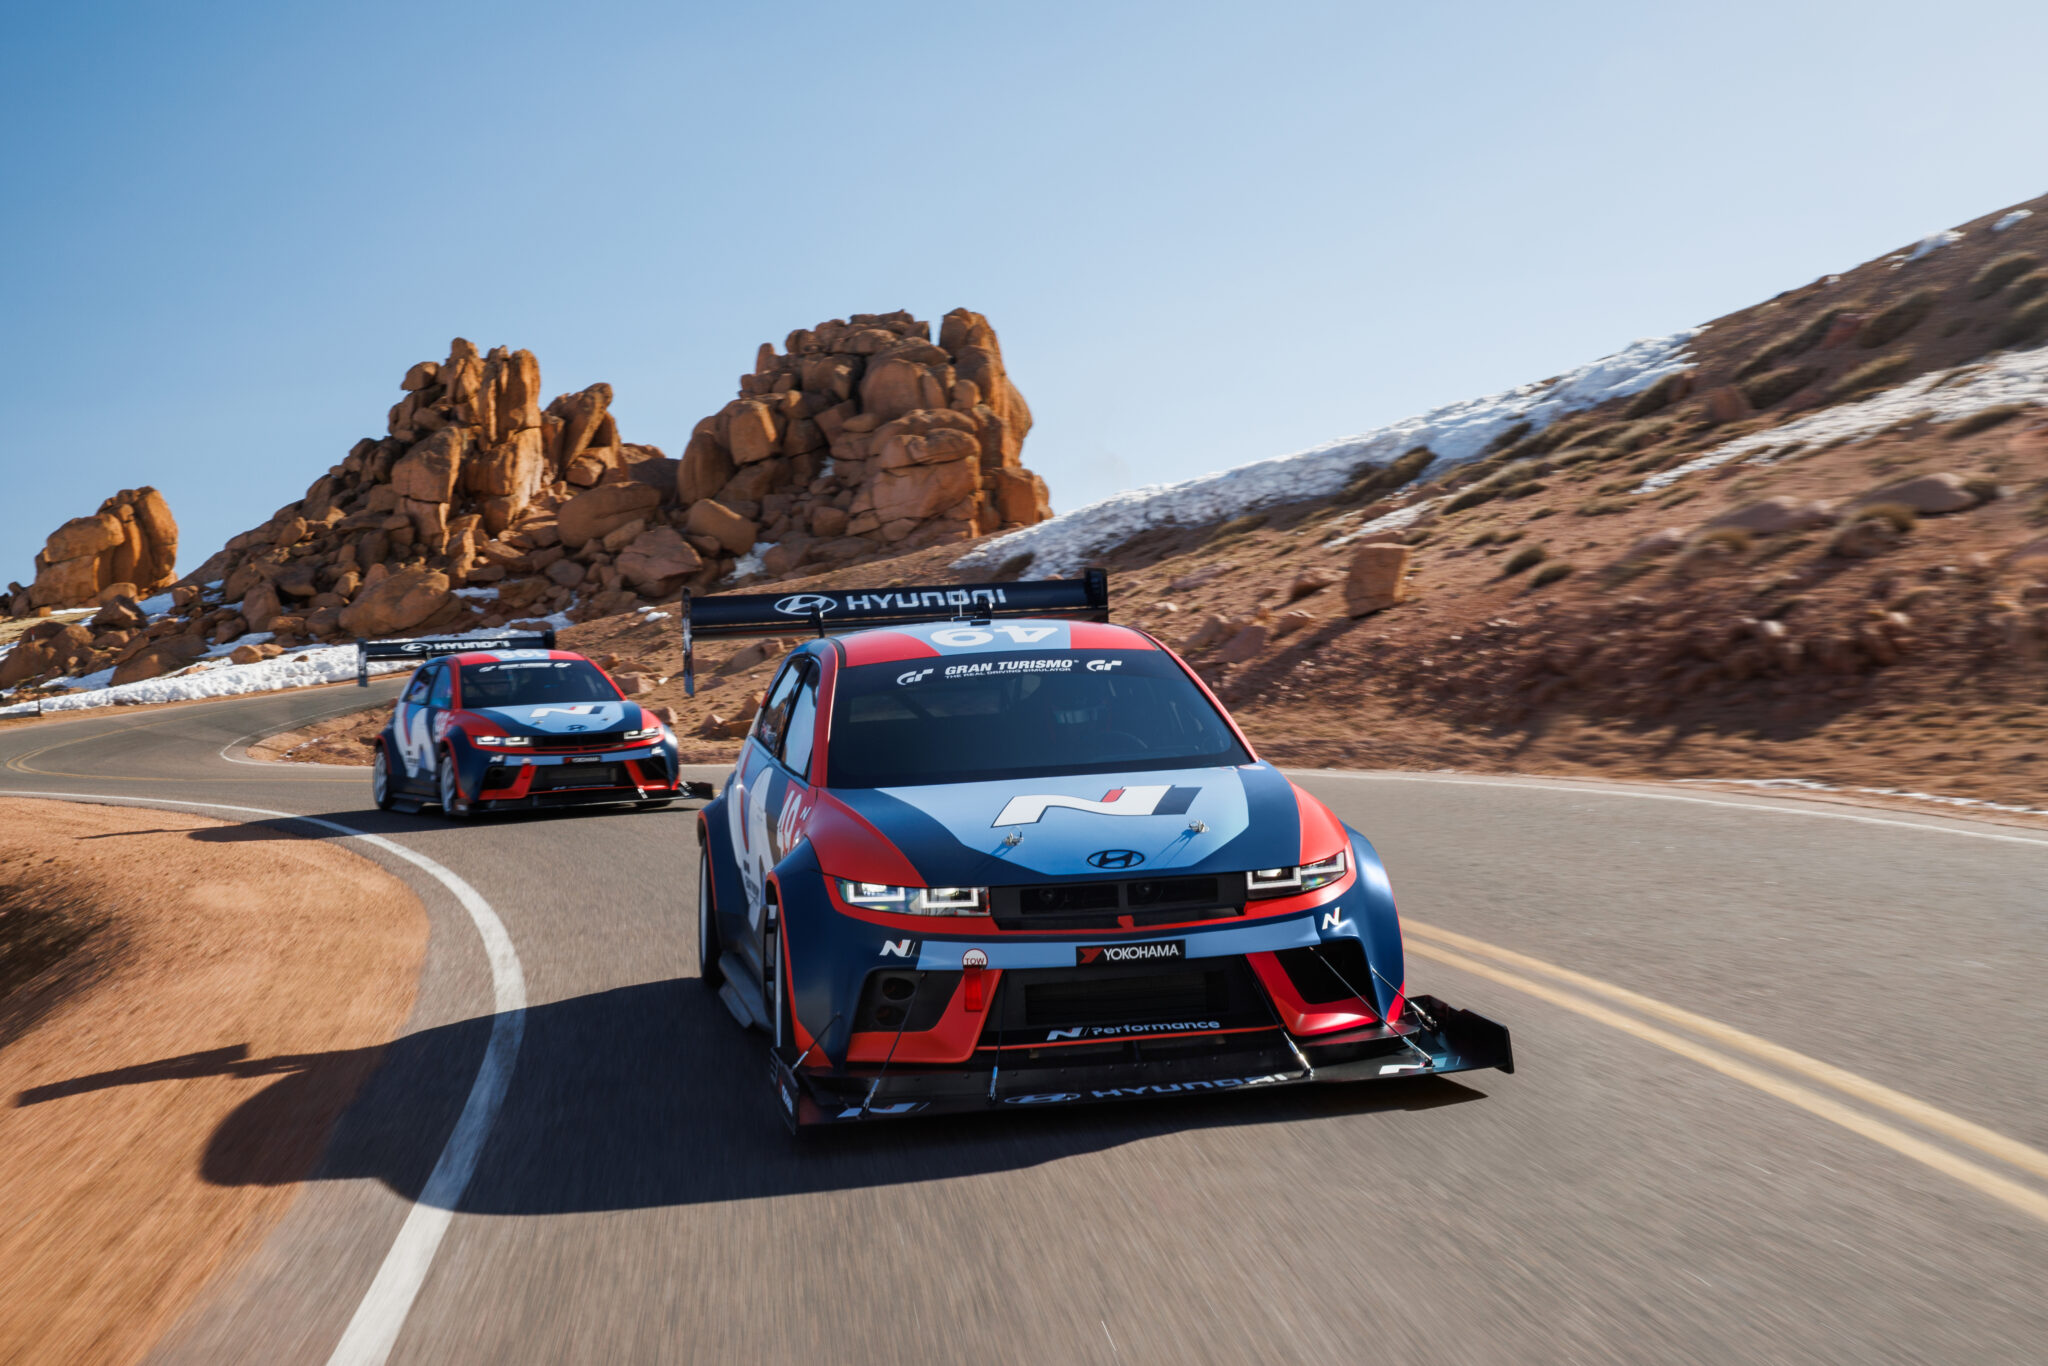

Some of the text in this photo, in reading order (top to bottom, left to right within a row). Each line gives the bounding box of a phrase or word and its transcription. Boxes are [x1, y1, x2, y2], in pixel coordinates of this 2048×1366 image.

[845, 589, 1007, 611] HYUNDAI
[944, 659, 1073, 676] GRAN TURISMO
[1103, 943, 1179, 961] YOKOHAMA
[965, 957, 985, 966] TOW
[1092, 1020, 1221, 1036] Performance
[1091, 1073, 1289, 1098] HYUNDAI
